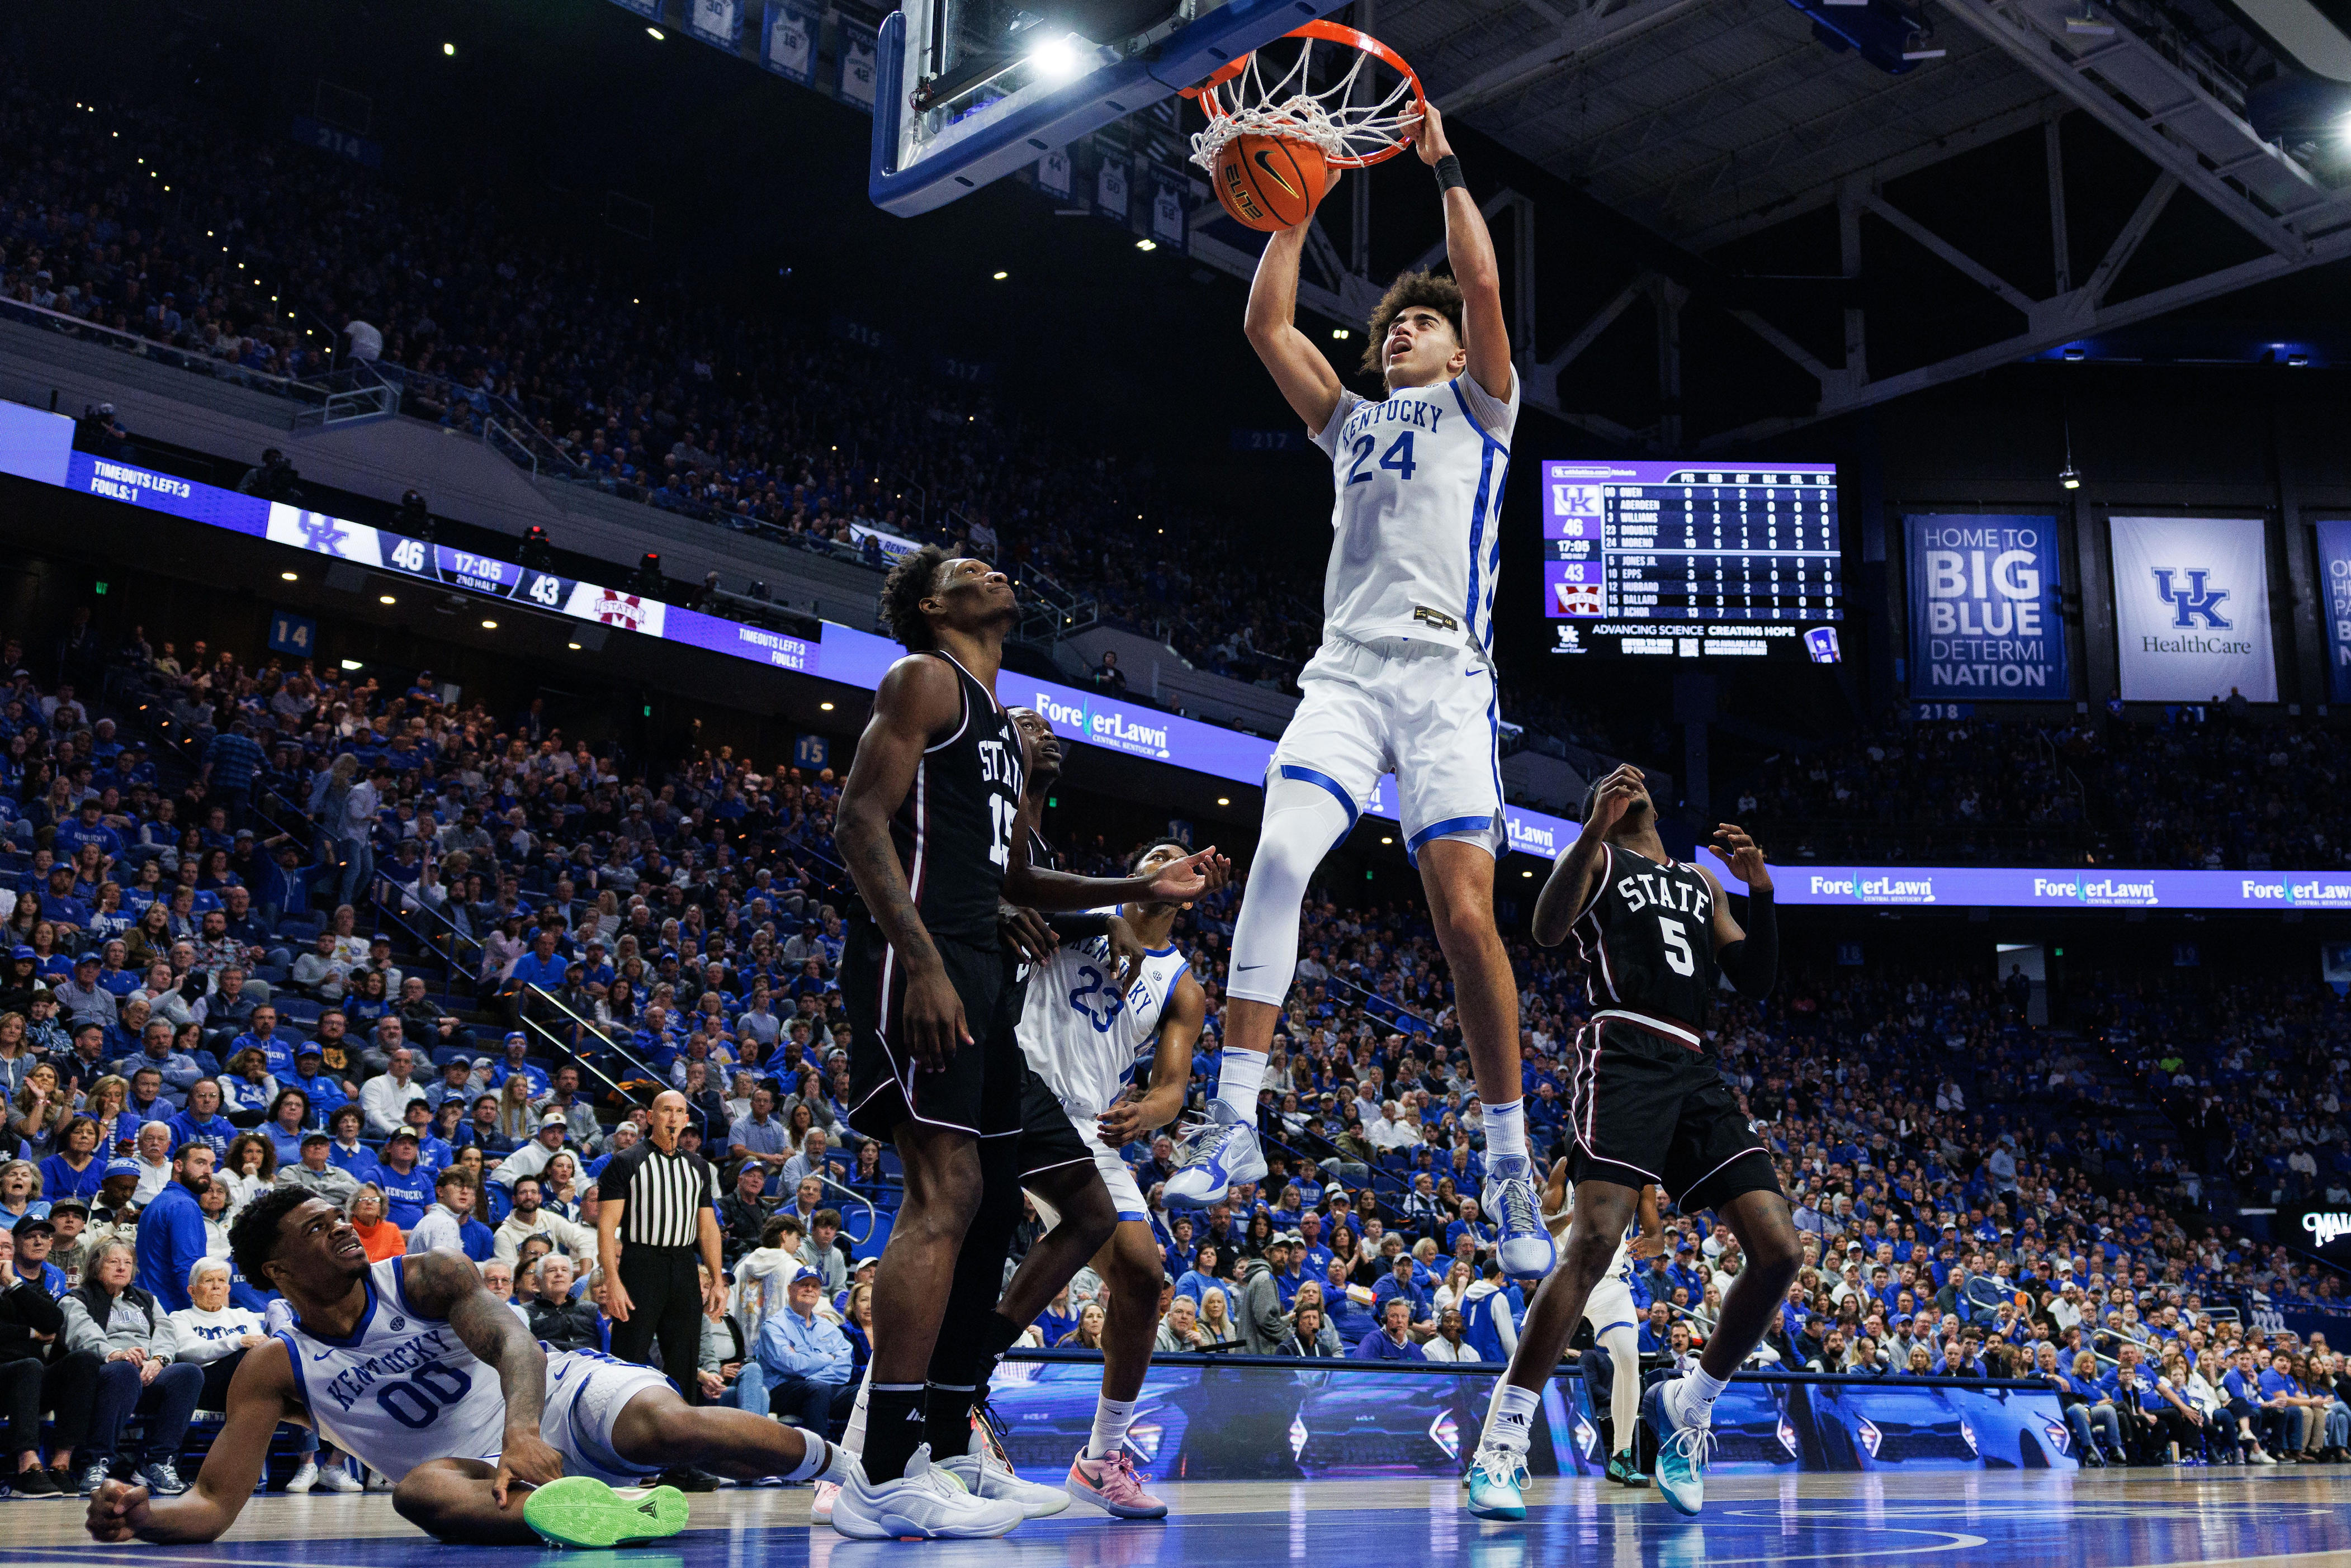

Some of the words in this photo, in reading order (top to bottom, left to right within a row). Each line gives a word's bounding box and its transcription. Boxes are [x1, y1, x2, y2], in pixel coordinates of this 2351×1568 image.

[318, 128, 359, 158] 214
[1226, 163, 1265, 220] ELITE
[1343, 399, 1442, 452] KENTUCKY
[1252, 433, 1287, 448] 217
[1346, 431, 1416, 487] 24
[94, 461, 152, 488] TIMEOUTS
[1681, 473, 1695, 483] PTS
[1708, 473, 1723, 483] REB
[1735, 473, 1750, 484] AST
[1763, 475, 1777, 484] BLK
[1790, 475, 1804, 484] STL
[1816, 475, 1829, 485] FLS
[1562, 487, 1594, 512] UK
[1685, 487, 1692, 498] 9
[1713, 488, 1719, 498] 1
[1739, 489, 1747, 499] 2
[1767, 489, 1775, 499] 0
[1794, 490, 1800, 499] 1
[1820, 490, 1827, 500] 2
[1609, 500, 1613, 510] 1
[1620, 500, 1660, 510] ABERDEEN
[1685, 500, 1692, 511] 6
[1714, 501, 1719, 511] 1
[1740, 501, 1747, 511] 2
[1767, 501, 1775, 511] 0
[1794, 502, 1801, 512] 0
[1820, 502, 1828, 513] 0
[1563, 518, 1583, 537] 46
[1607, 513, 1614, 523] 3
[1620, 513, 1658, 523] WILLIAMS
[1685, 513, 1693, 523] 9
[1713, 513, 1720, 524] 2
[1740, 514, 1747, 524] 1
[1768, 514, 1776, 524] 0
[1795, 514, 1802, 525] 2
[1821, 515, 1829, 525] 0
[1606, 525, 1616, 535] 23
[1686, 526, 1693, 536] 2
[1714, 526, 1721, 536] 4
[1742, 527, 1747, 537] 1
[1768, 527, 1776, 537] 0
[1795, 527, 1803, 537] 0
[1822, 527, 1829, 538] 0
[1925, 528, 1999, 547] HOME
[2004, 529, 2037, 548] TO
[1557, 540, 1590, 552] 17:05
[1606, 538, 1617, 547] 24
[1621, 538, 1653, 548] MORENO
[1684, 538, 1696, 548] 10
[1714, 539, 1721, 548] 5
[1742, 539, 1749, 549] 3
[1770, 539, 1777, 549] 0
[1796, 539, 1803, 549] 3
[1823, 540, 1829, 549] 1
[391, 539, 425, 571] 46
[454, 553, 503, 580] 17:05
[1609, 556, 1615, 566] 5
[1622, 556, 1645, 566] JONES
[1647, 556, 1658, 566] JR.
[1687, 557, 1694, 566] 2
[1716, 557, 1721, 567] 1
[1742, 557, 1749, 567] 2
[1771, 558, 1776, 567] 1
[1797, 558, 1804, 568] 0
[1825, 558, 1830, 568] 1
[1564, 563, 1584, 581] 43
[1609, 569, 1617, 579] 10
[1623, 569, 1642, 579] EPPS
[1688, 570, 1695, 580] 3
[1716, 570, 1722, 580] 3
[1744, 570, 1749, 580] 1
[1771, 571, 1778, 580] 0
[1798, 571, 1805, 581] 0
[1824, 571, 1832, 581] 0
[1926, 549, 2040, 600] BIG
[456, 574, 475, 589] 2ND
[474, 577, 498, 593] HALF
[529, 575, 560, 605] 43
[1609, 582, 1617, 591] 12
[1623, 582, 1659, 593] HUBBARD
[1686, 582, 1697, 593] 15
[1717, 583, 1722, 593] 1
[1744, 583, 1751, 593] 2
[1771, 584, 1778, 593] 0
[1799, 584, 1805, 593] 1
[1825, 584, 1832, 594] 0
[1568, 594, 1599, 604] STATE
[1609, 595, 1618, 604] 15
[1623, 595, 1657, 605] BALLARD
[1689, 595, 1695, 605] 2
[1717, 596, 1723, 605] 3
[1745, 596, 1750, 605] 1
[1773, 596, 1778, 605] 1
[1799, 596, 1806, 606] 0
[1826, 597, 1833, 607] 0
[2151, 566, 2232, 631] UK
[602, 601, 636, 618] STATE
[1608, 607, 1619, 617] 99
[1624, 607, 1649, 617] ACHOR
[1687, 608, 1698, 618] 13
[1717, 608, 1724, 618] 7
[1745, 608, 1751, 618] 1
[1773, 609, 1780, 618] 0
[1800, 609, 1806, 619] 2
[1827, 609, 1833, 619] 2
[1929, 601, 2042, 636] BLUE
[278, 620, 308, 647] 14
[739, 628, 779, 649] TIMEOUTS
[1592, 624, 1657, 635] ADVANCING
[1659, 625, 1704, 636] SCIENCE
[1708, 626, 1763, 636] CREATING
[1765, 627, 1796, 637] HOPE
[1932, 639, 2044, 661] DETERMI
[2142, 636, 2251, 655] HealthCare
[1920, 704, 1958, 719] 218
[801, 741, 823, 763] 15
[1092, 734, 1121, 748] CENTRAL
[1122, 741, 1156, 756] KENTUCKY
[1617, 874, 1709, 923] STATE
[1658, 916, 1695, 977] 5
[1069, 965, 1124, 1032] 23
[385, 1186, 424, 1201] KENTUCKY
[2302, 1212, 2351, 1247] MAL
[1469, 1304, 1477, 1327] 1
[327, 1330, 451, 1412] KENTUCKY
[377, 1361, 471, 1429] 00
